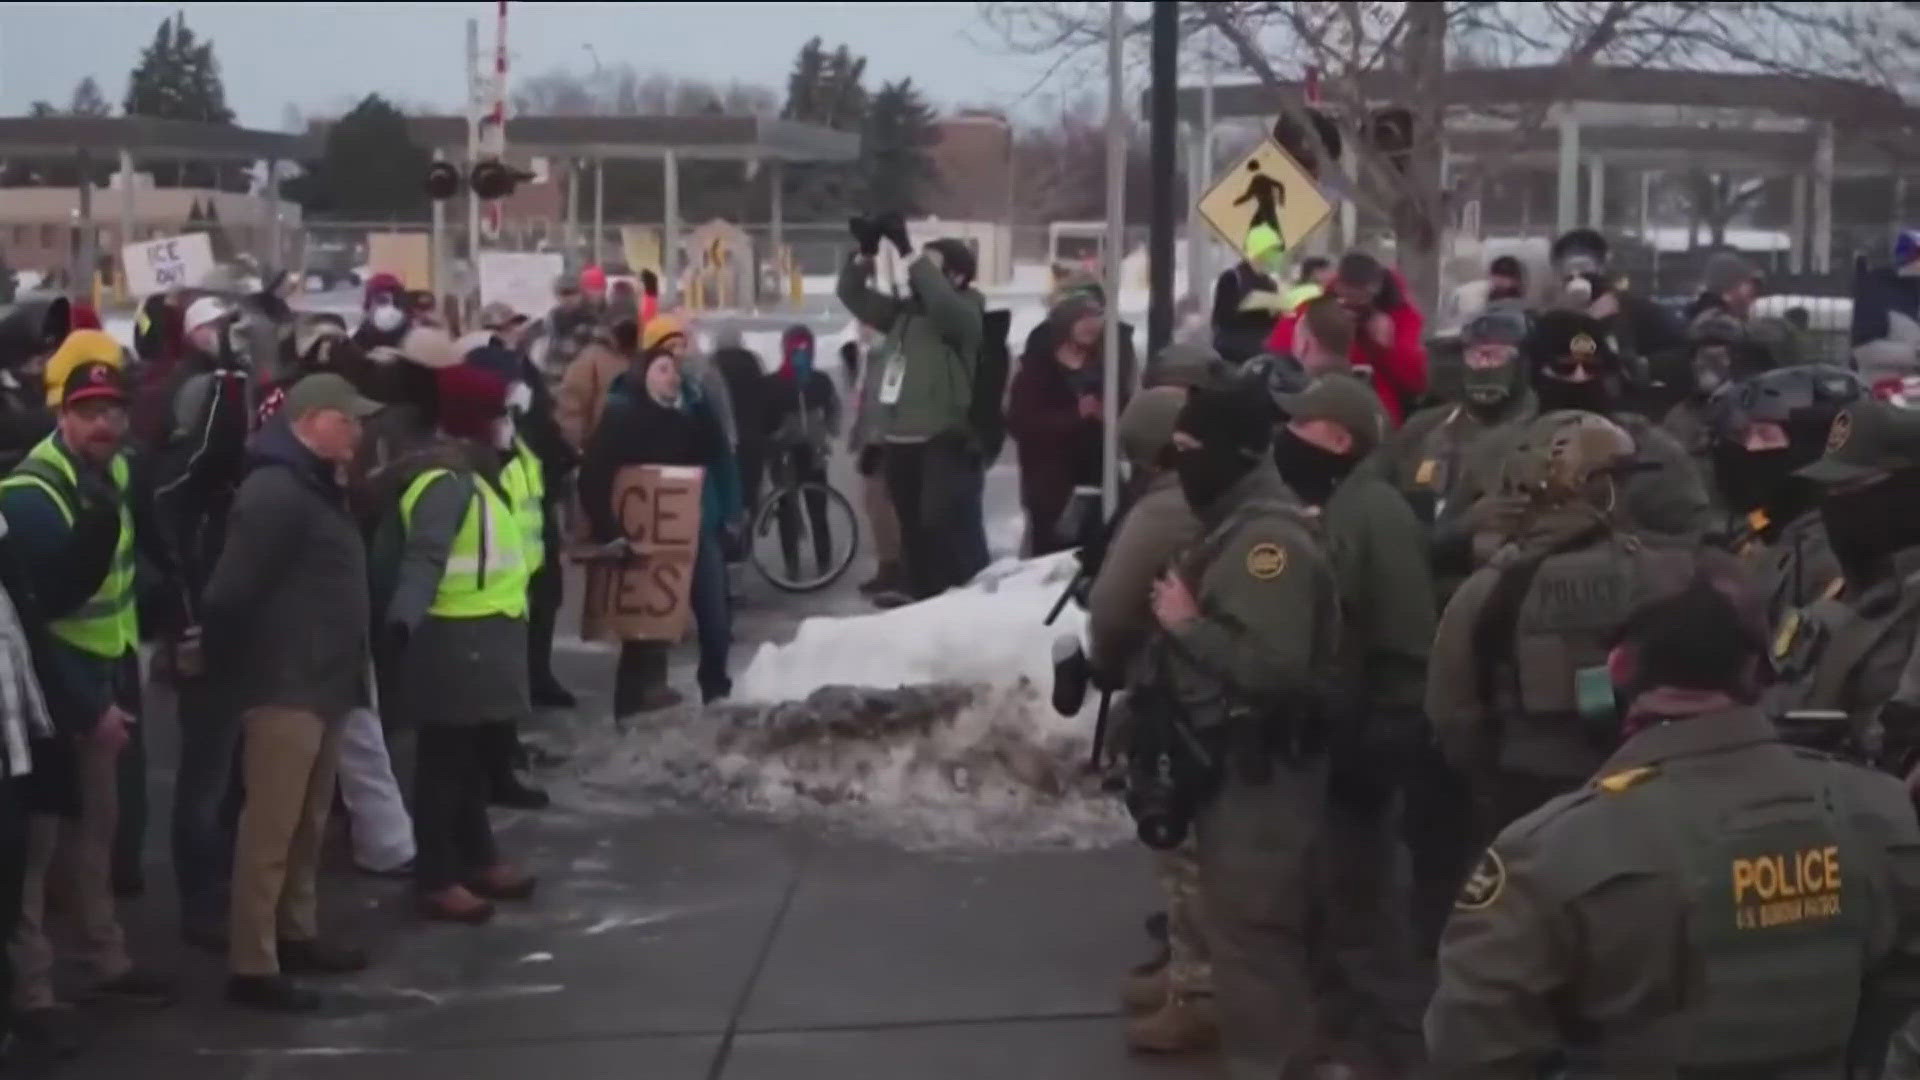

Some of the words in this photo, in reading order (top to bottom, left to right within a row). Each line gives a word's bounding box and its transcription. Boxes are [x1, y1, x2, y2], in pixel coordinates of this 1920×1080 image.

[147, 241, 180, 262] ICE
[156, 263, 186, 285] OUT
[618, 485, 691, 545] CE
[1733, 846, 1841, 904] POLICE
